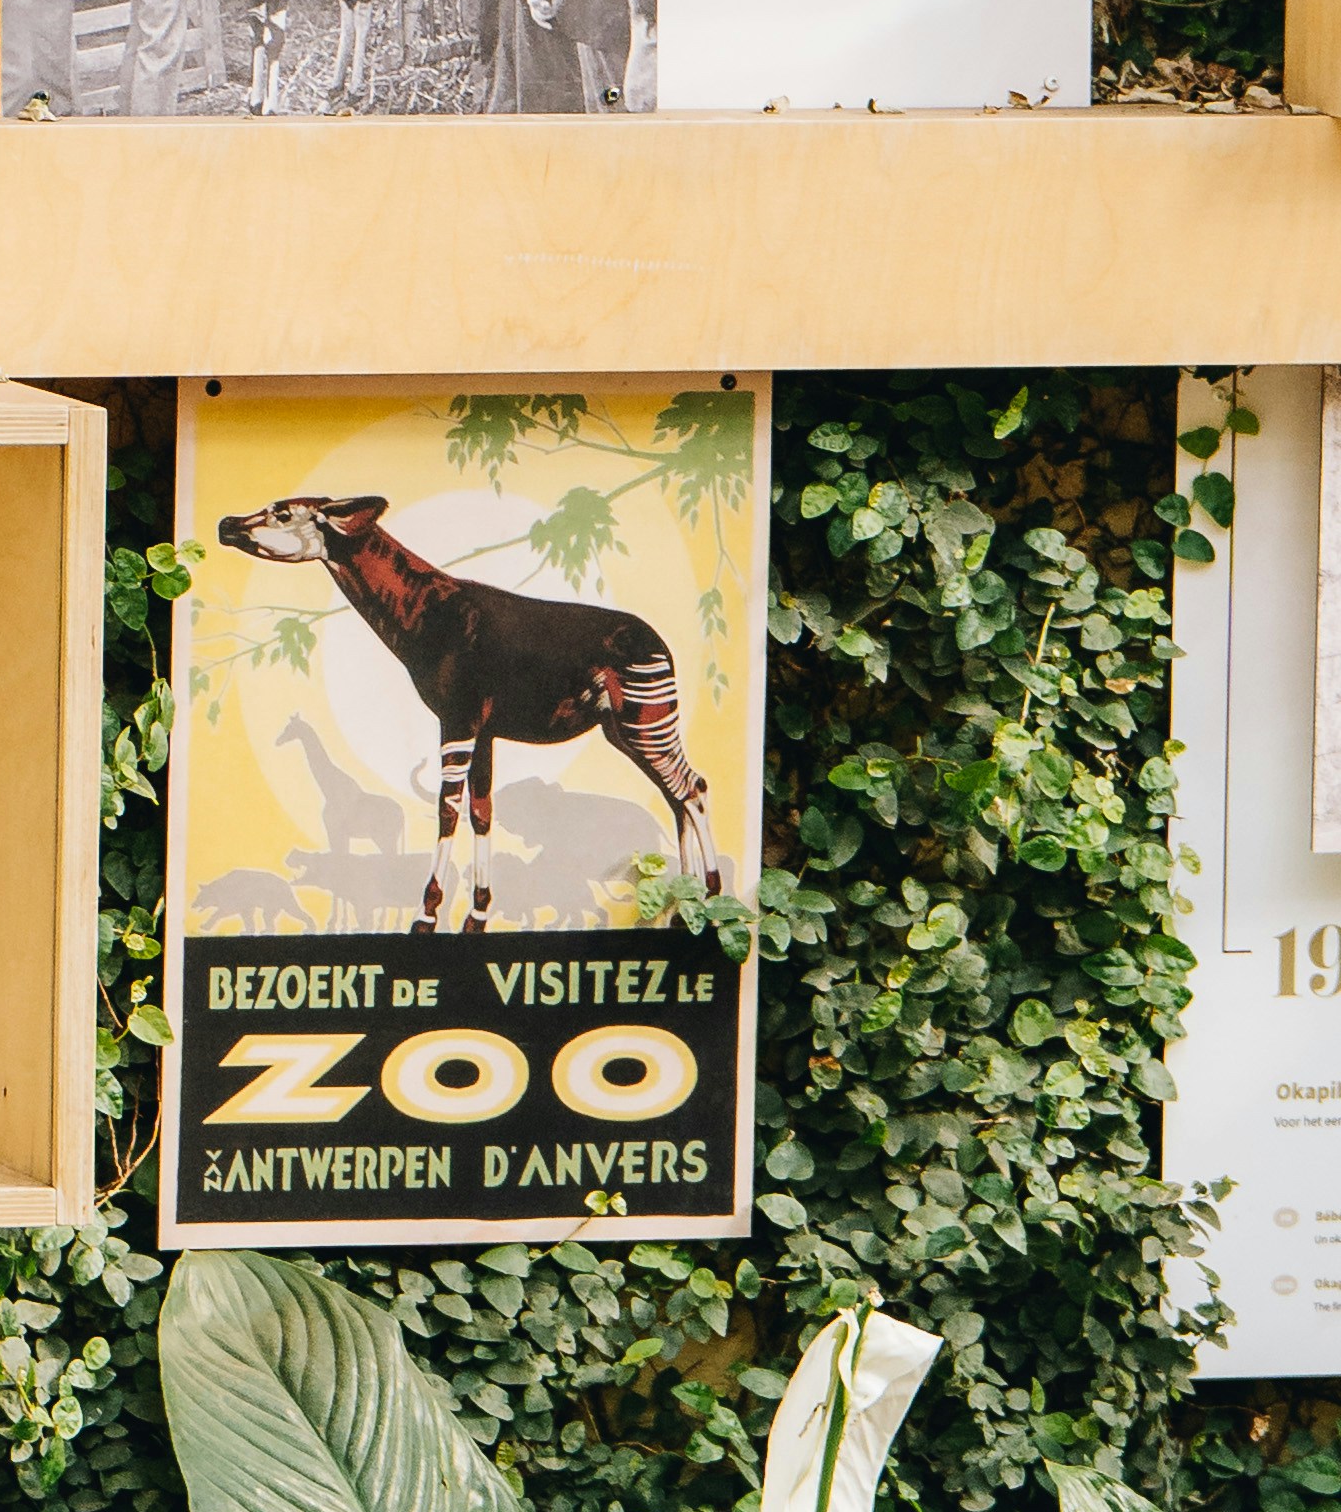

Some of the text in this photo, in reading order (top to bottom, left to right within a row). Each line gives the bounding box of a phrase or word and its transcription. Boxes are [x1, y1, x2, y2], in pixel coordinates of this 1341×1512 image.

[208, 964, 440, 1010] BEZOEKT DE
[486, 960, 715, 1005] VISITEZ LE
[202, 1025, 698, 1124] ZOO
[1274, 1116, 1301, 1128] Voor
[1303, 1114, 1322, 1127] het
[223, 1146, 452, 1193] ANTWERPEN
[483, 1139, 708, 1188] D'ANVERS
